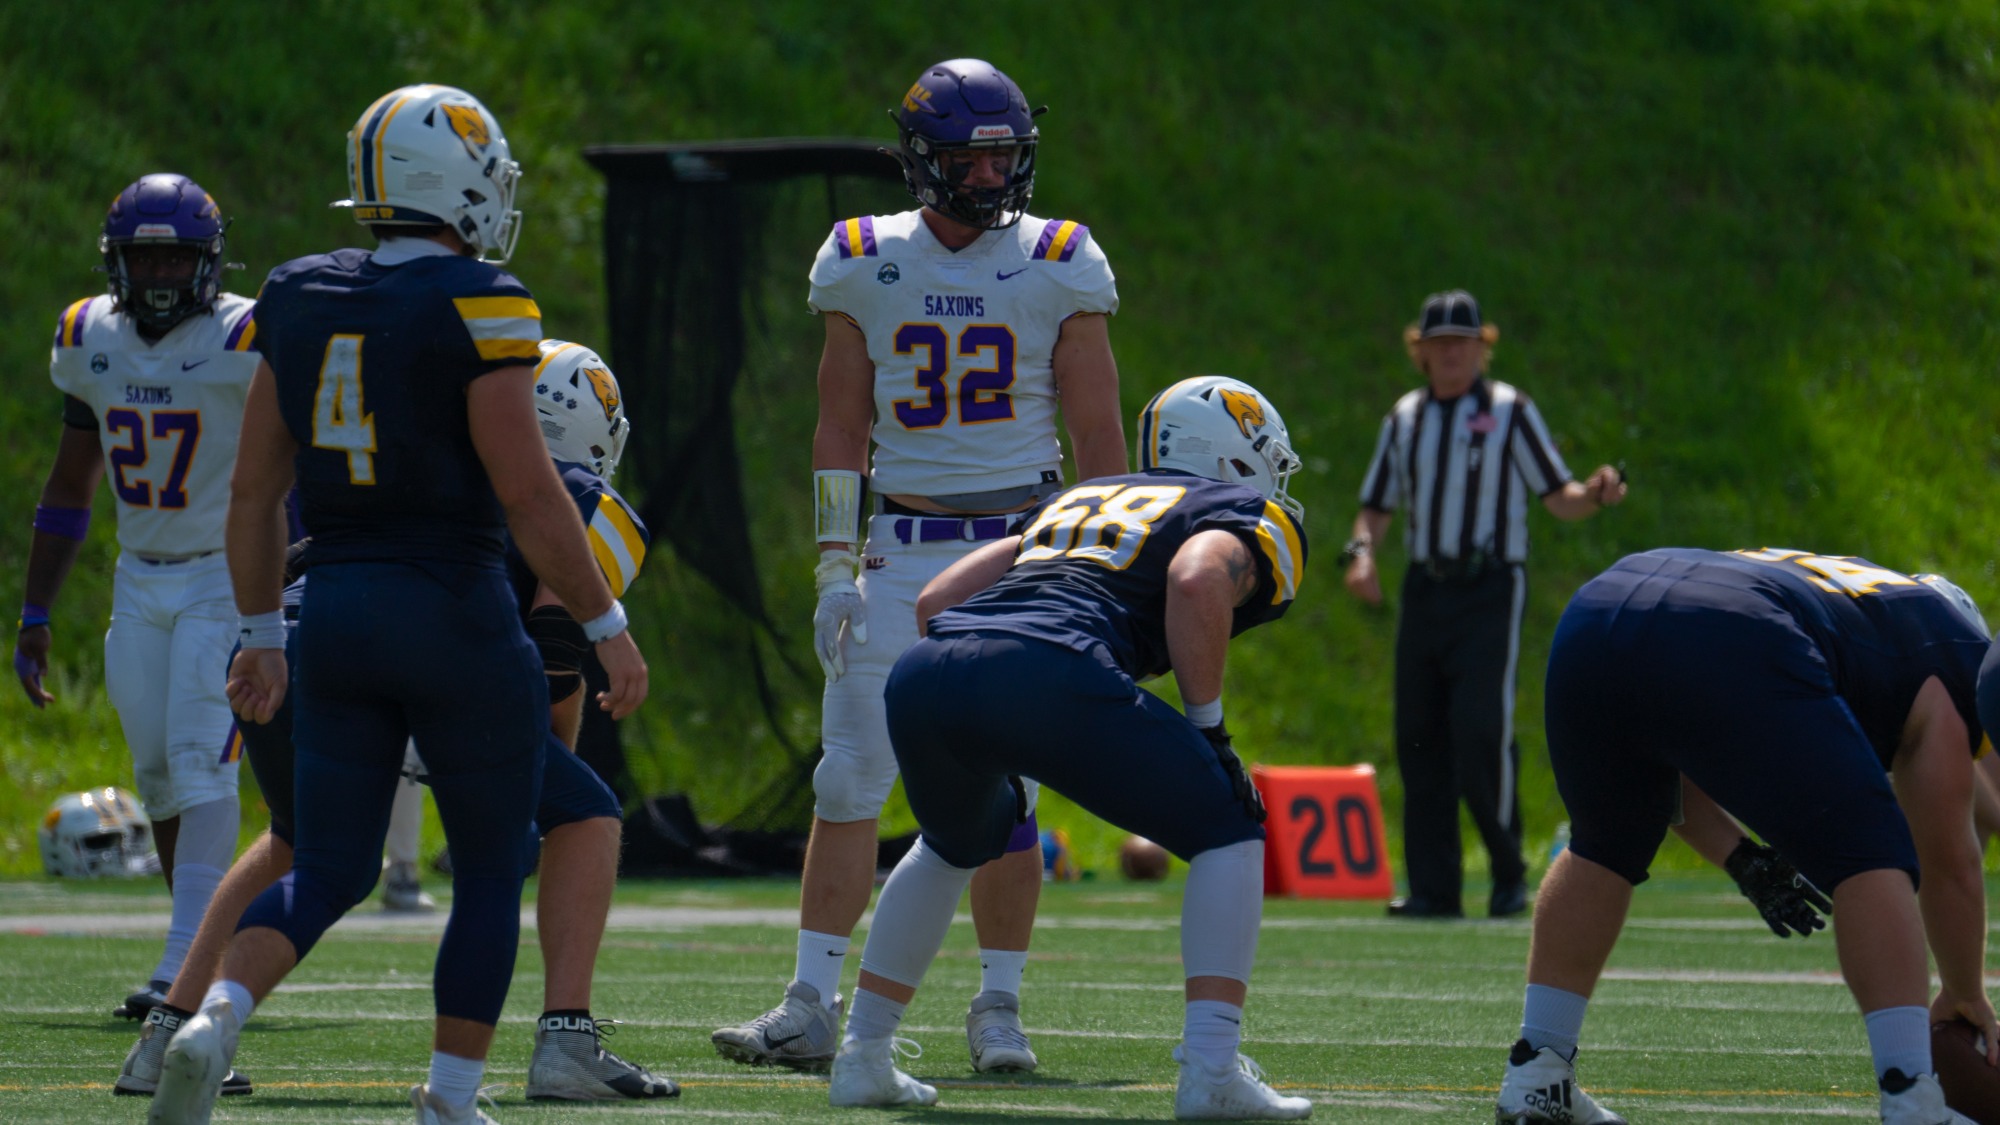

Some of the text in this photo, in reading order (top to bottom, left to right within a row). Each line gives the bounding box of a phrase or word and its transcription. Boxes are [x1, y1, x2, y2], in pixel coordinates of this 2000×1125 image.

[977, 128, 1010, 136] Riddell
[925, 295, 984, 317] SAXONS
[125, 384, 173, 405] SAXONS
[892, 321, 1017, 431] 32
[312, 333, 378, 485] 4
[105, 405, 203, 511] 27
[1013, 484, 1187, 571] 68
[1290, 795, 1378, 876] 20
[145, 1009, 186, 1031] DE
[1524, 1094, 1575, 1123] adidas
